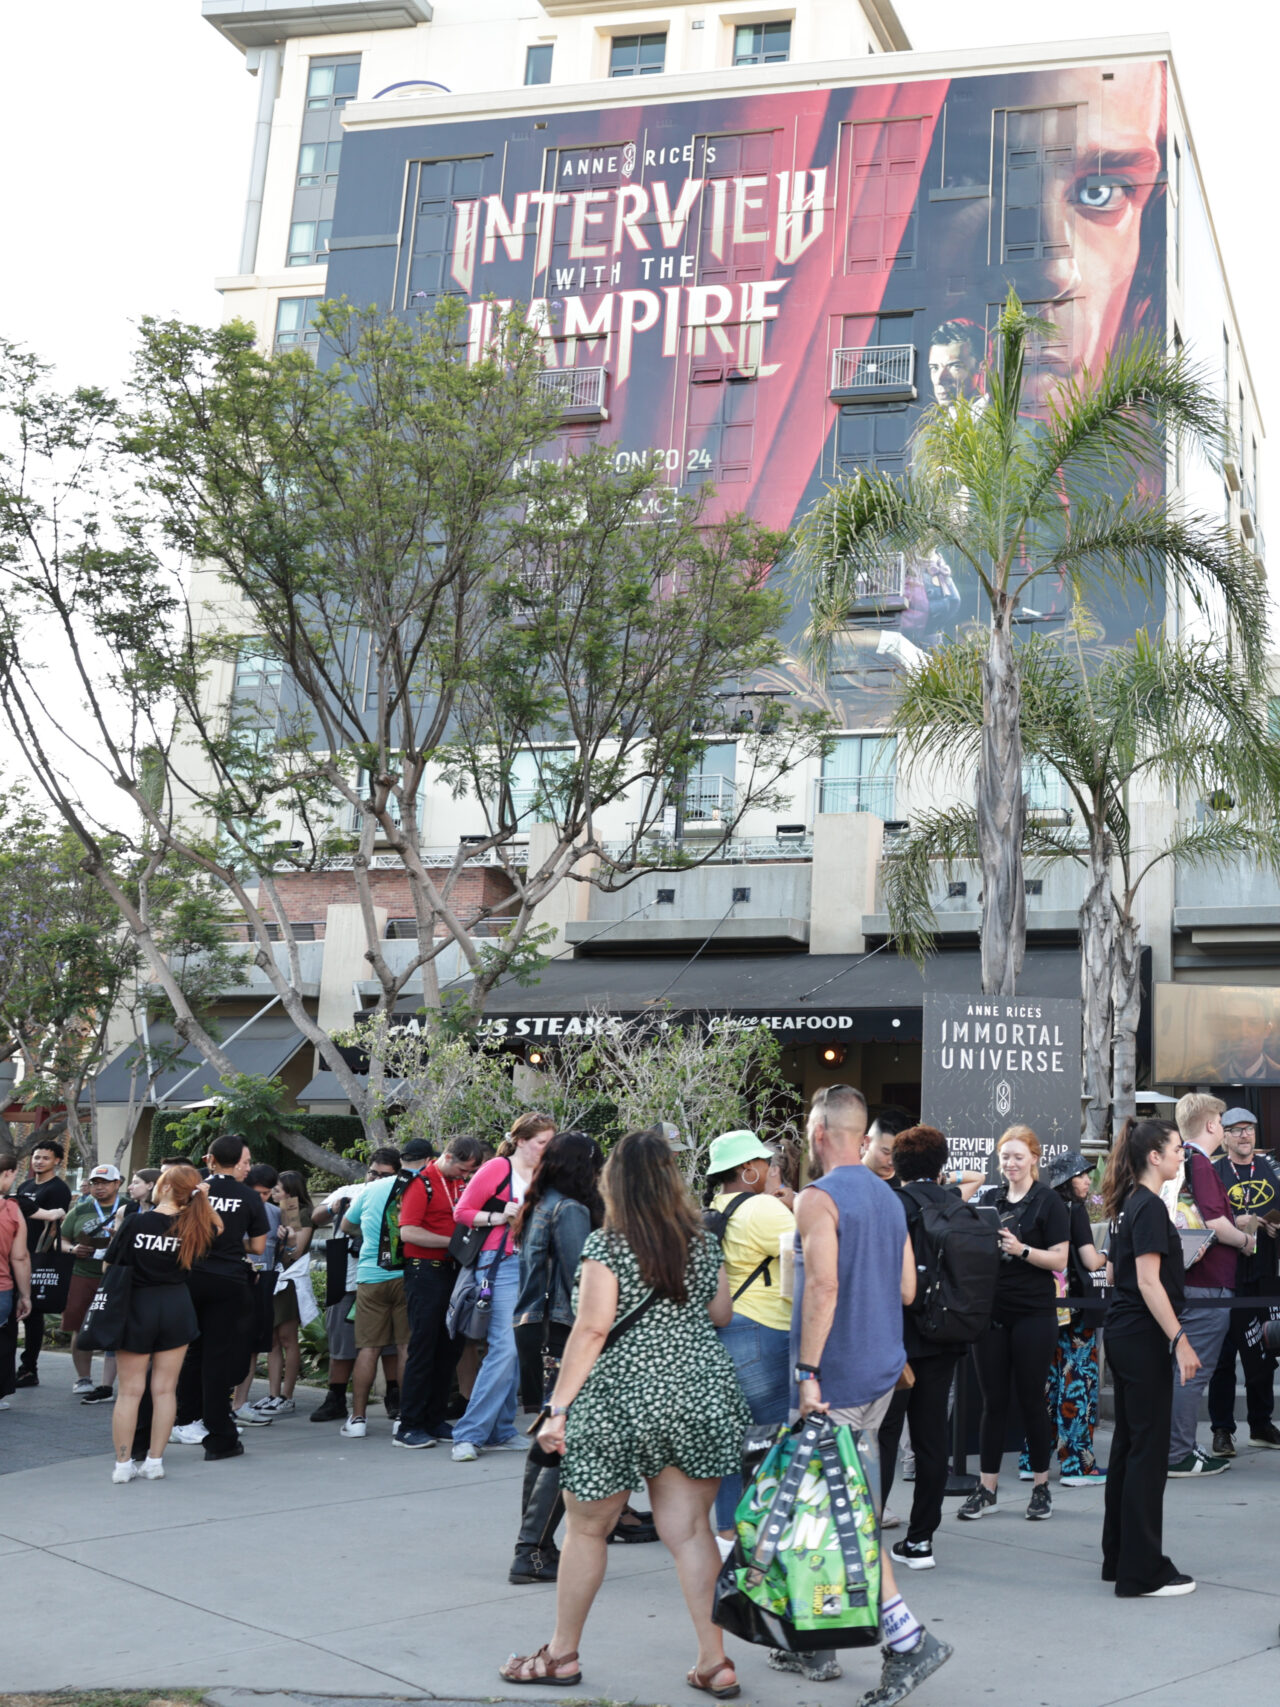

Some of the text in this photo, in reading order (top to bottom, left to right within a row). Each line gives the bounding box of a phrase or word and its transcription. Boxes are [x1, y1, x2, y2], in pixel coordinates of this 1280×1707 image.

[563, 146, 717, 176] ANNE RICE'S
[450, 168, 829, 295] INTERVIEW
[556, 255, 695, 291] WITH THE
[967, 1005, 1042, 1018] ANNE RICE'S
[515, 1017, 623, 1036] STEAKS
[761, 1016, 854, 1029] SEAFOOD
[941, 1019, 1064, 1047] IMMORTAL
[941, 1047, 1064, 1073] UNIVERSE
[945, 1137, 995, 1155] TERVIEW
[942, 1157, 989, 1174] AMPIRE
[208, 1196, 242, 1212] TAFF
[134, 1233, 182, 1252] STAFF
